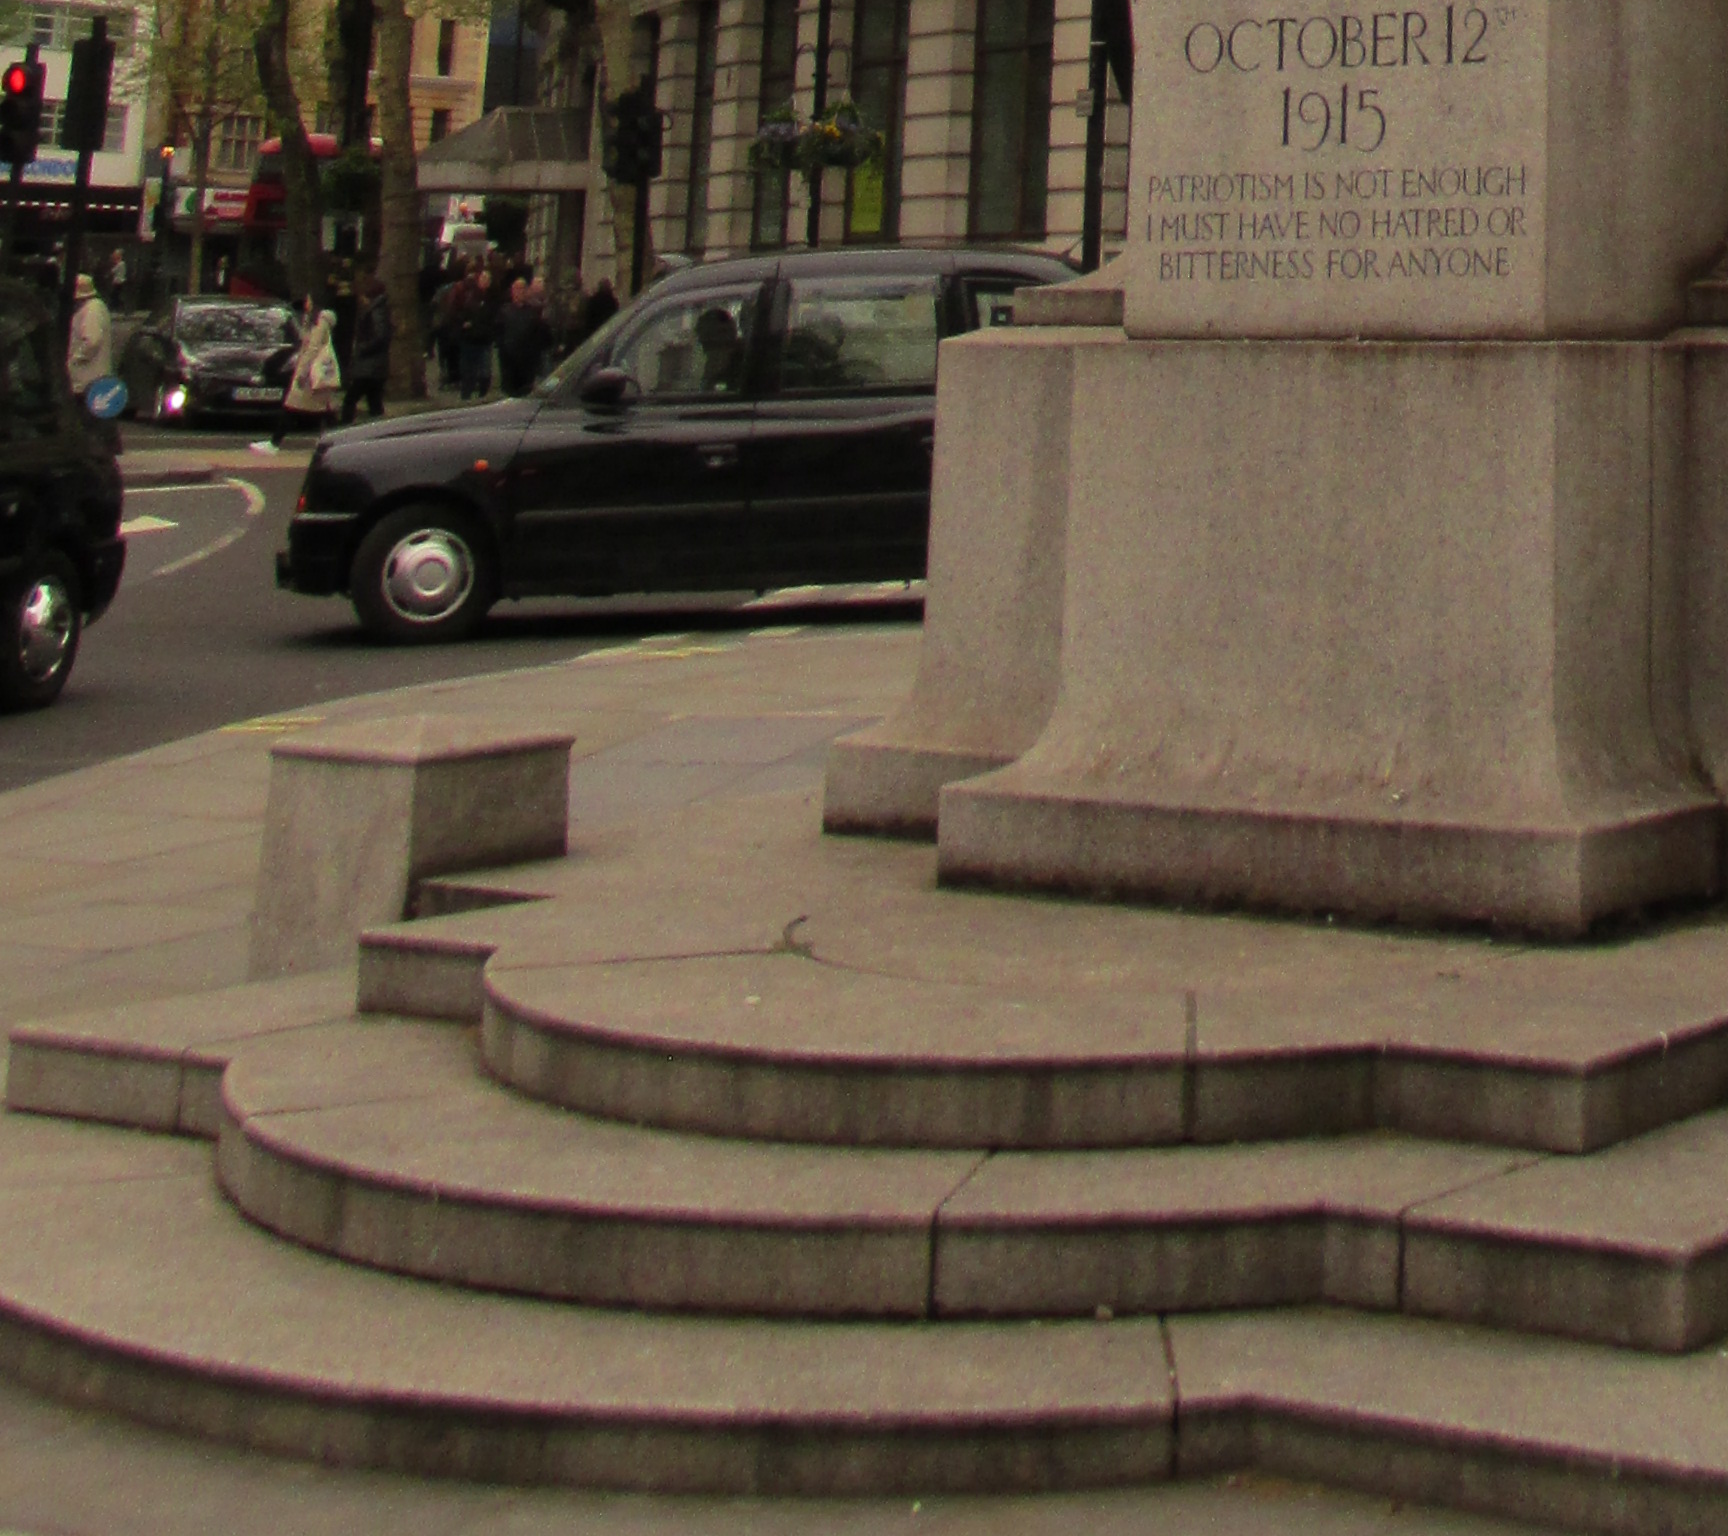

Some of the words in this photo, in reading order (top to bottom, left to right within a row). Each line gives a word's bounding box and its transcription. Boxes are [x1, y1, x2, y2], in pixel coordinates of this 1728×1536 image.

[1185, 9, 1430, 73] OCTOBER
[1281, 82, 1387, 152] 1915
[1148, 171, 1294, 204] PATRIOTISM
[1304, 170, 1326, 199] IS
[1335, 169, 1393, 198] NOT
[1402, 165, 1527, 198] ENOUGH
[1146, 214, 1154, 242] I
[1160, 212, 1231, 241] MUST
[1238, 210, 1309, 240] HAVE
[1318, 211, 1361, 240] NO
[1372, 208, 1480, 238] HATRED
[1486, 207, 1528, 237] OR
[1159, 250, 1314, 282] BITTERNESS
[1327, 248, 1382, 280] FOR
[1388, 246, 1510, 278] ANYONE
